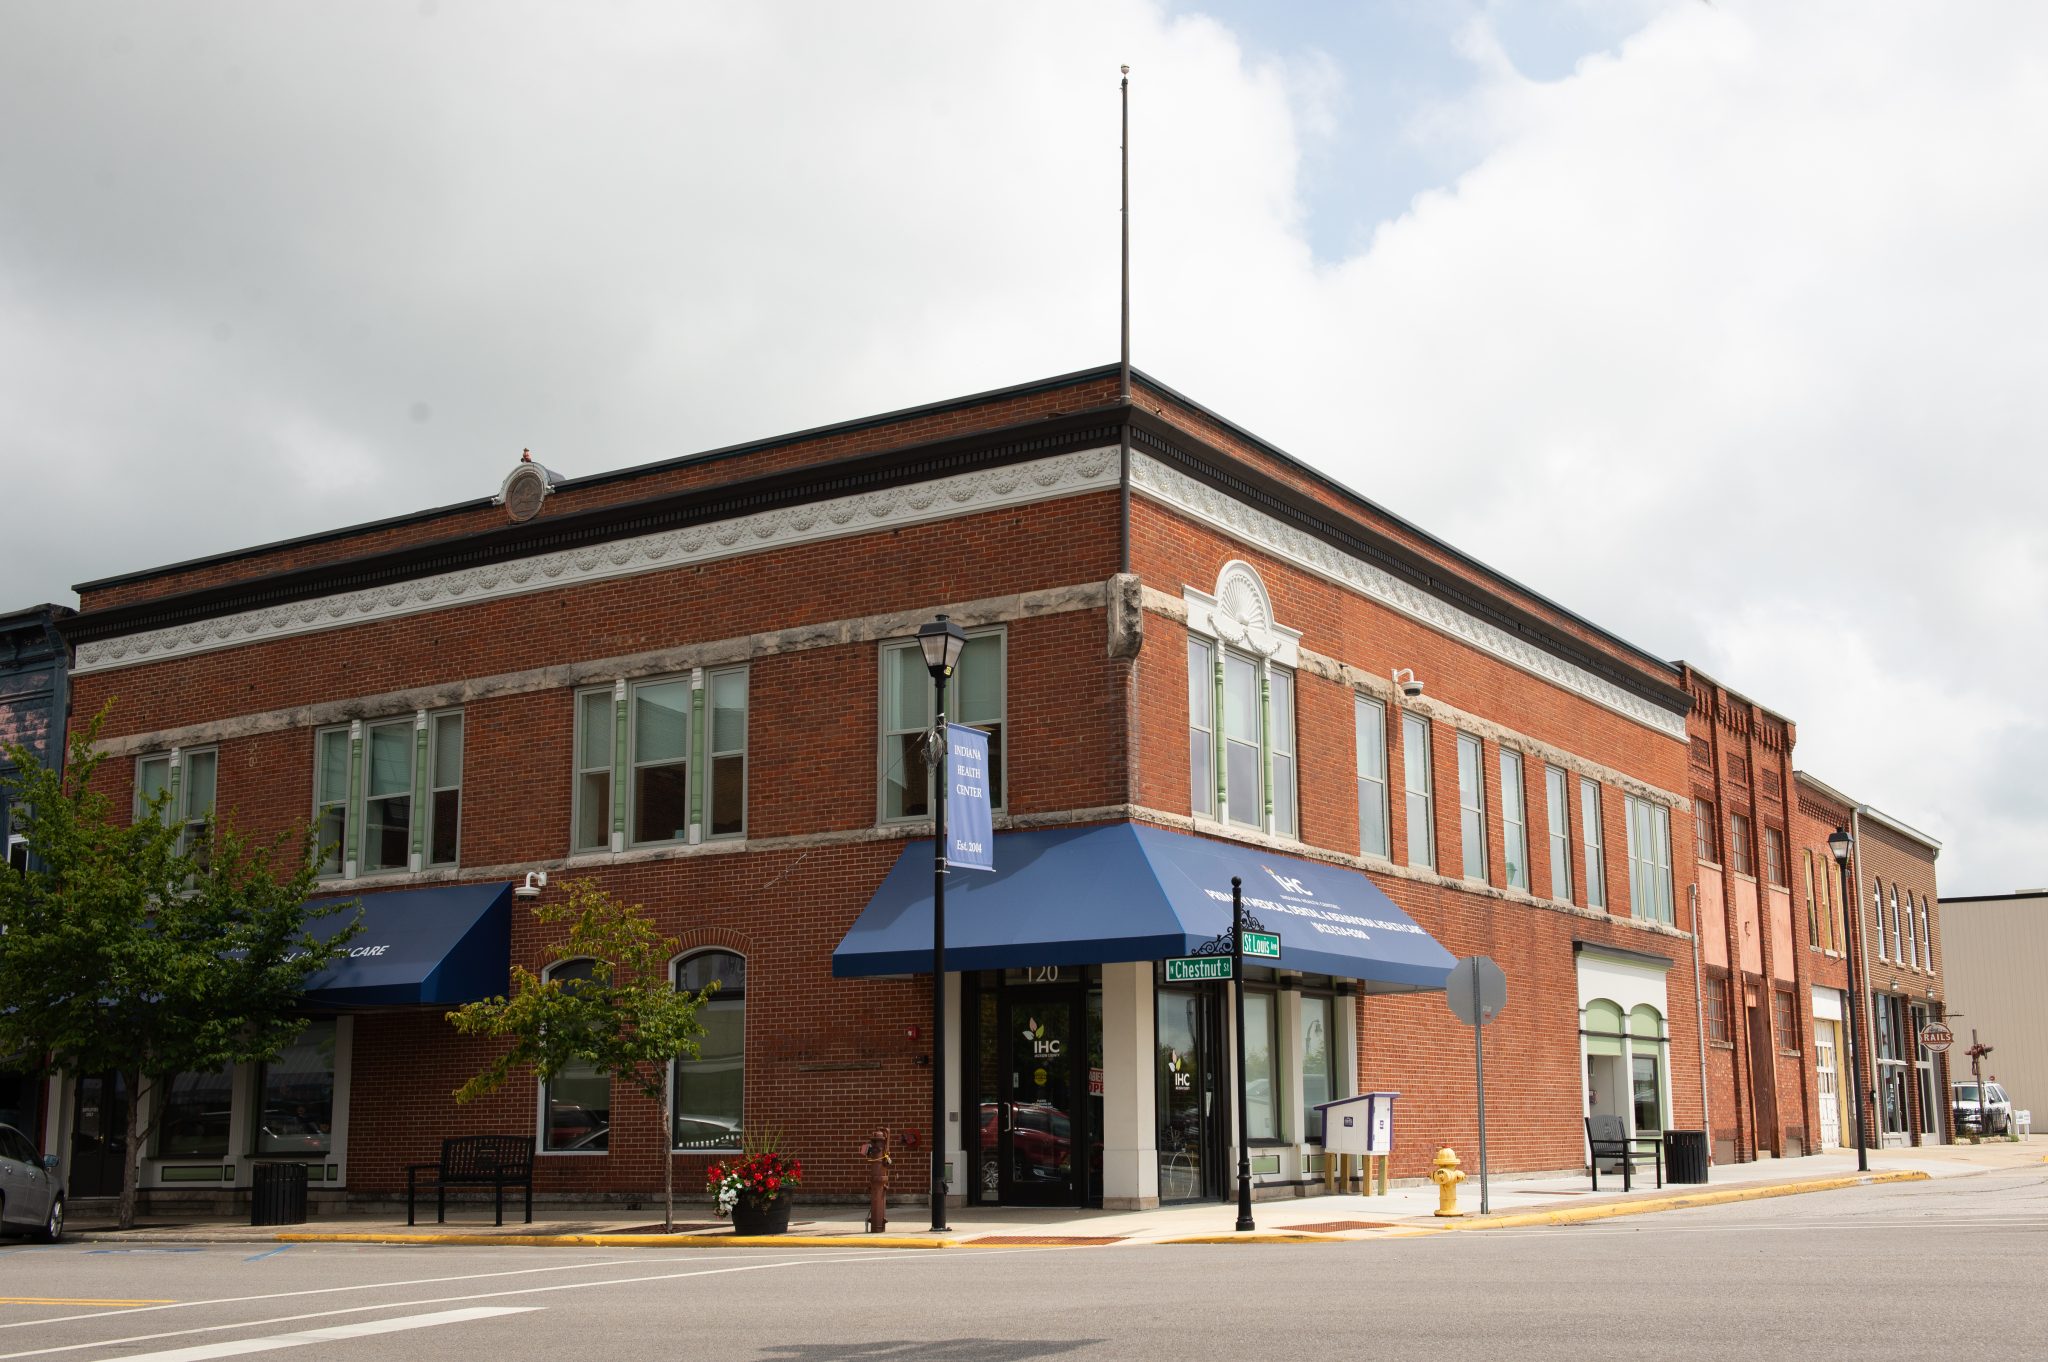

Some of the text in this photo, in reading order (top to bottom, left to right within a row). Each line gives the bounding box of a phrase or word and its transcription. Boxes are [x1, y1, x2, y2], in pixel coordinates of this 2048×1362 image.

[954, 744, 981, 761] INDIANA
[957, 764, 981, 779] HEALTH
[956, 783, 982, 798] CENTER
[956, 839, 982, 854] Est. 2004
[1272, 873, 1313, 896] IHC
[350, 945, 390, 958] CARE
[1244, 934, 1252, 953] St
[1253, 936, 1270, 954] Louis
[1027, 966, 1058, 983] 120
[1169, 960, 1229, 978] N Chestnut St
[1924, 1033, 1951, 1041] RAILS
[1034, 1040, 1060, 1053] IHC
[1175, 1073, 1190, 1086] IHC
